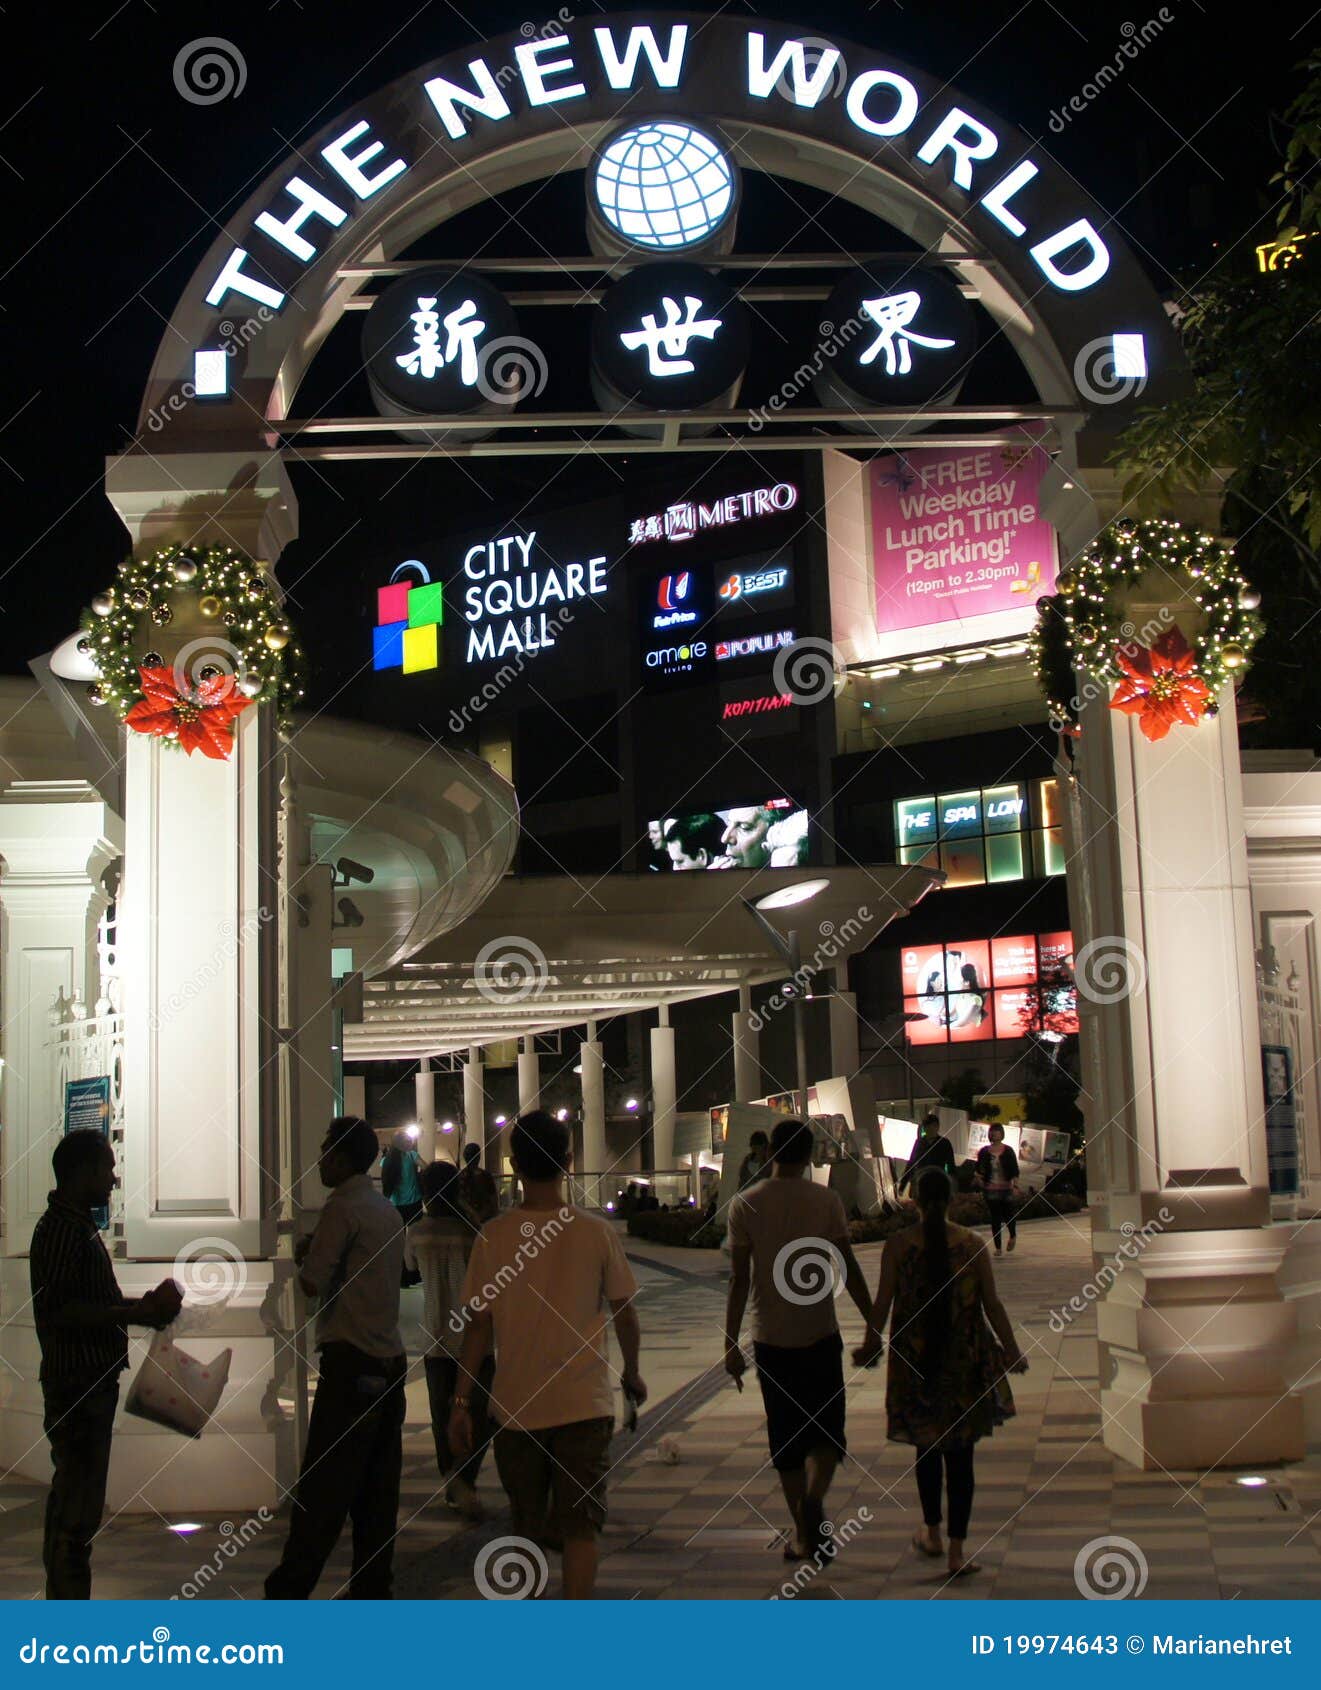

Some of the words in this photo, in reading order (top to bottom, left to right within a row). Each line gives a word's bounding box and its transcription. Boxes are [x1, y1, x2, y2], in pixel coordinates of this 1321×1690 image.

[205, 120, 407, 310] THE
[423, 24, 689, 140] NEW
[747, 31, 1111, 292] WORLD
[396, 290, 956, 387] 新世界
[921, 453, 993, 489] FREE
[698, 483, 797, 528] METRO
[900, 480, 1016, 521] Weekday
[886, 515, 964, 550] Lunch
[967, 504, 1036, 533] Time
[464, 531, 537, 581] CITY
[464, 556, 608, 622] SQUARE
[742, 569, 788, 594] BEST
[906, 579, 945, 597] (12pm
[948, 573, 962, 587] to
[965, 562, 1020, 583] 2.30pm)
[466, 612, 556, 663] MALL
[645, 641, 708, 667] amore
[731, 630, 796, 657] POPULAR
[722, 693, 794, 720] KOPITIAM
[901, 812, 931, 828] THE
[943, 805, 977, 824] SPA
